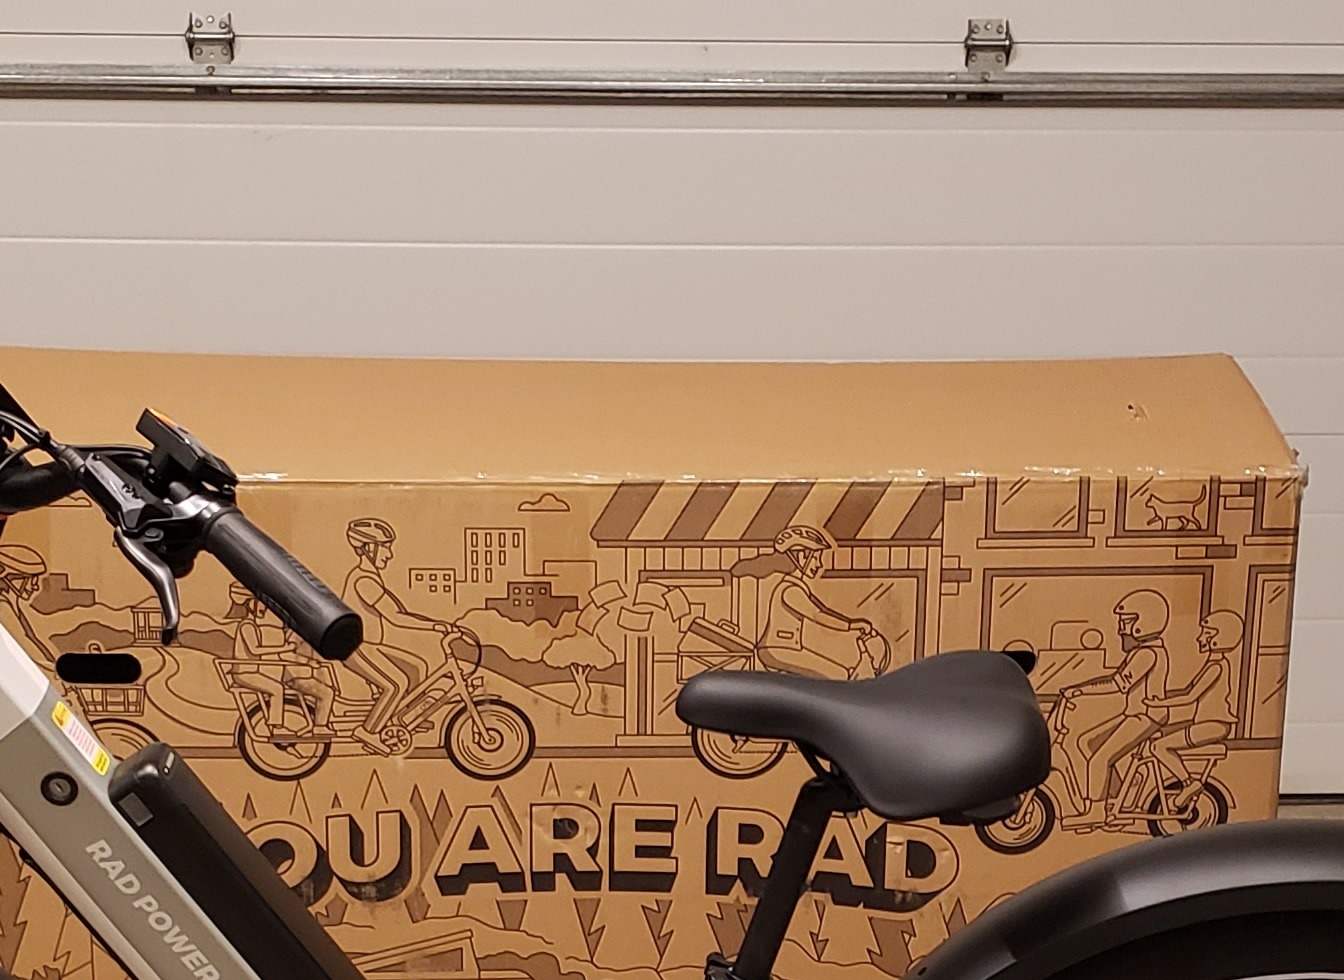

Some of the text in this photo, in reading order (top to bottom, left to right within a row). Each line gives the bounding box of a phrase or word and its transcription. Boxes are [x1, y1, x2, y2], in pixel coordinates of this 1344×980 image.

[85, 839, 141, 895] RAD
[244, 803, 960, 911] OU ARE RAD
